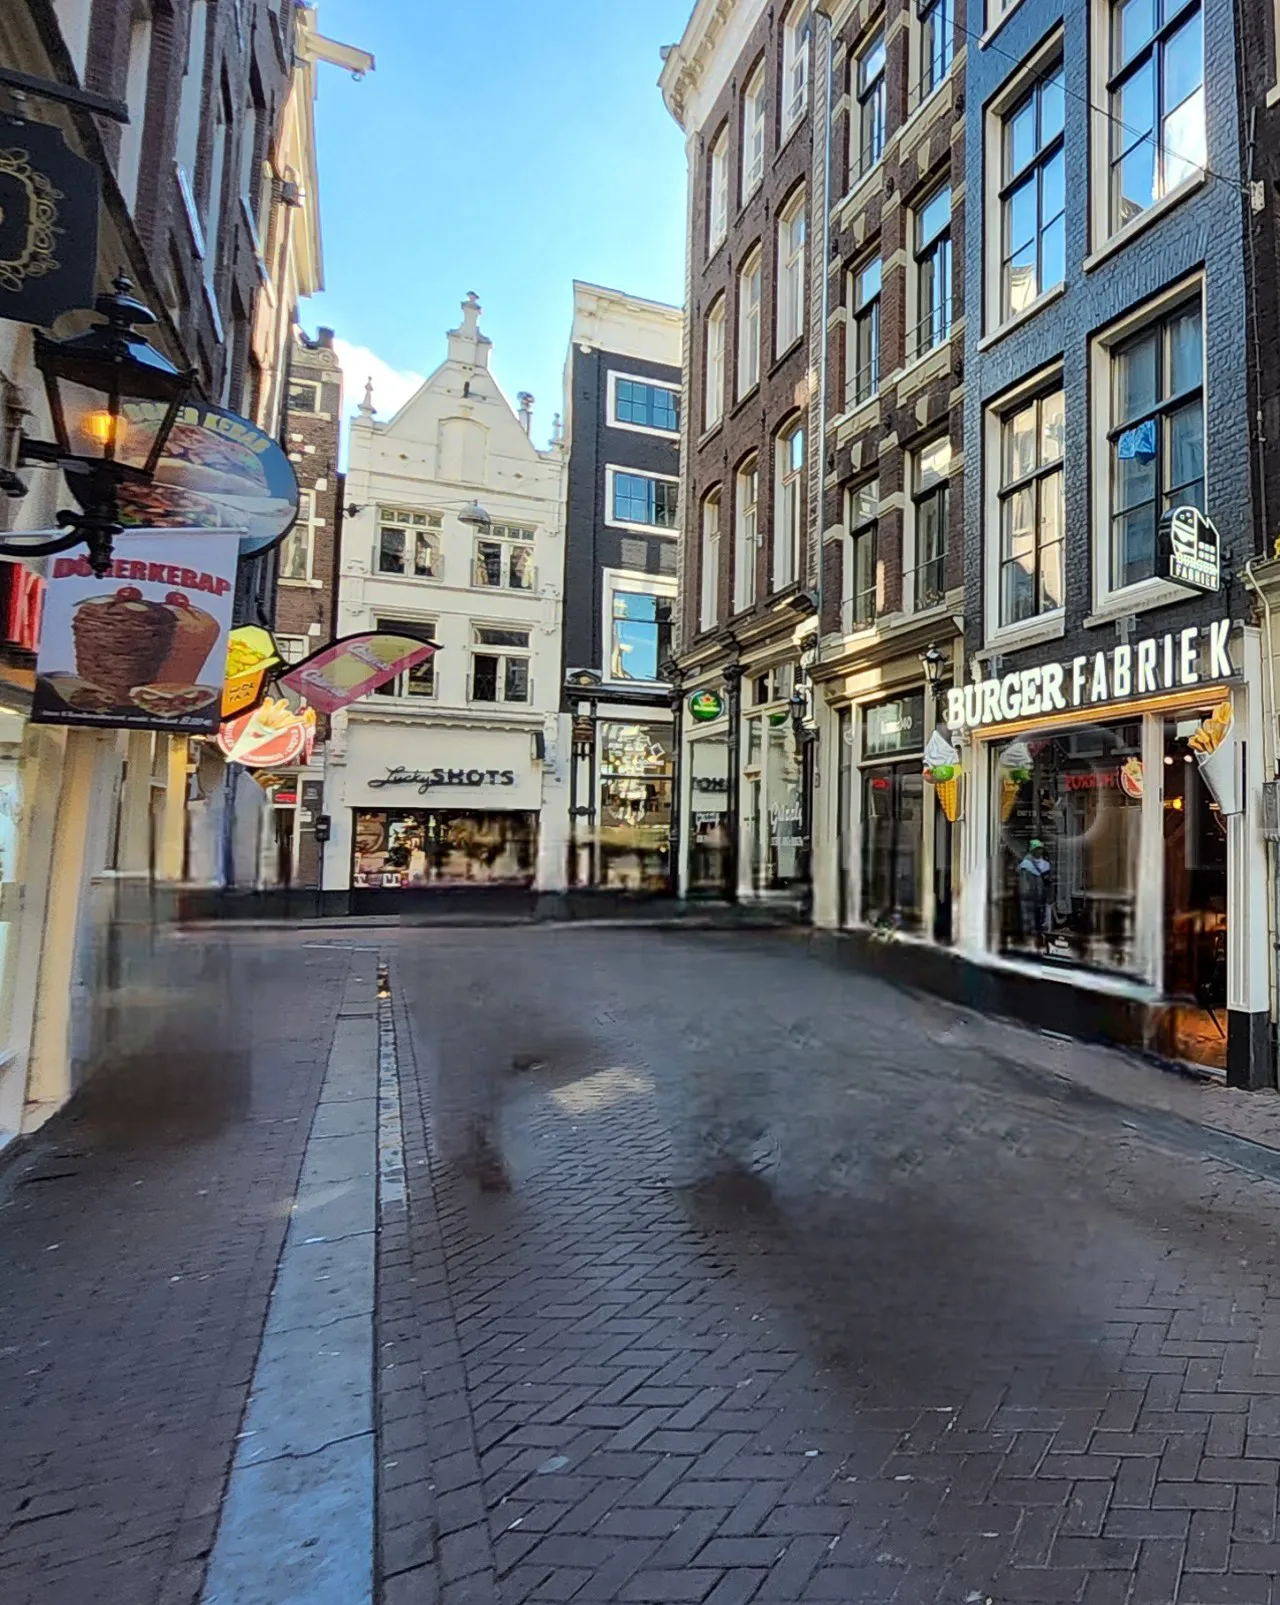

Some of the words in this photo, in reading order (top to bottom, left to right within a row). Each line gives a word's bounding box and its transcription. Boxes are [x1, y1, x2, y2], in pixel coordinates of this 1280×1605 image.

[53, 554, 231, 597] DÖERKEBAP
[946, 661, 1066, 731] BURGER
[1073, 618, 1232, 706] FABRIEK
[367, 766, 431, 795] Lucky
[429, 768, 514, 787] SHOTS
